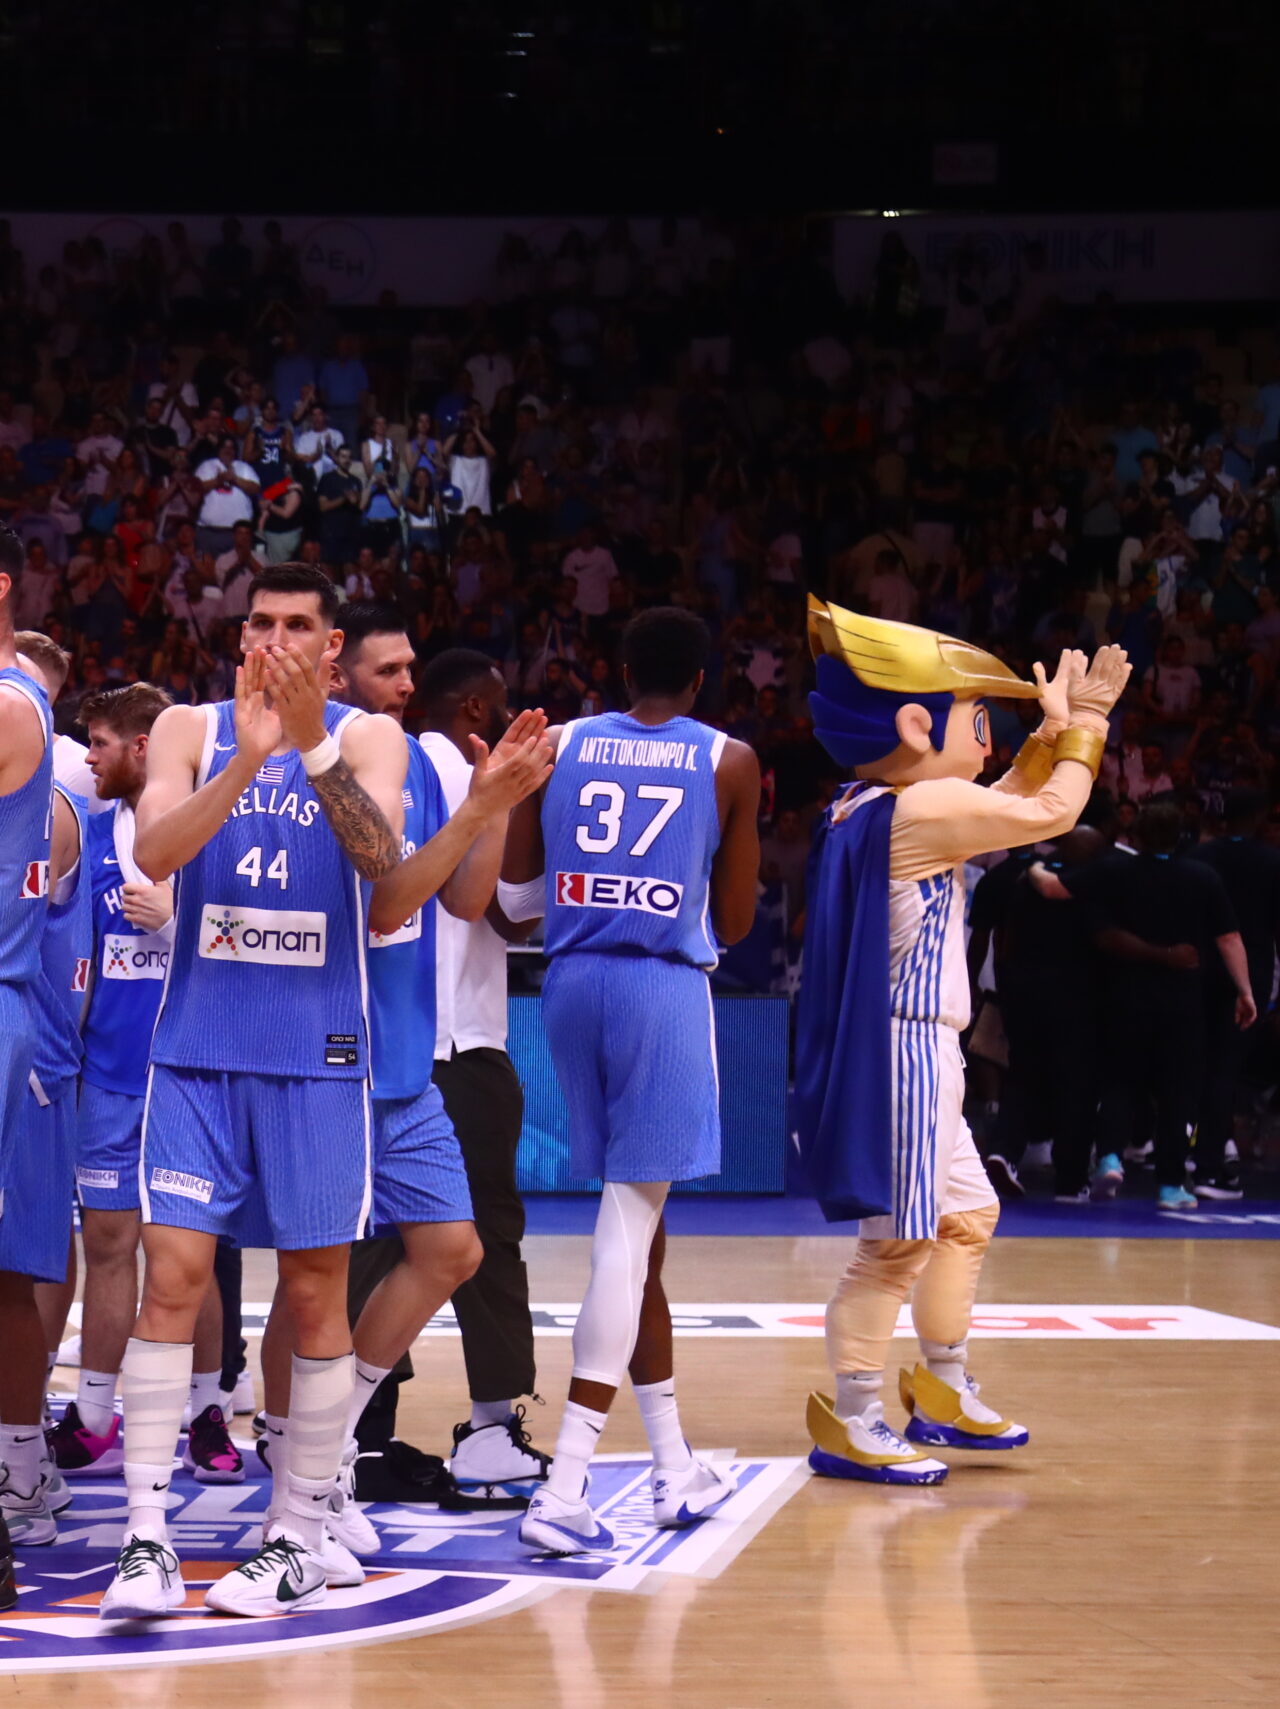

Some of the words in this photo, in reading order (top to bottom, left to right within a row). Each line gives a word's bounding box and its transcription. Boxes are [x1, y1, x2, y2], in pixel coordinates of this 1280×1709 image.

[261, 446, 280, 465] 34
[577, 737, 684, 769] ANTETOKOUNMPO
[684, 744, 698, 771] K.
[575, 778, 686, 858] 37
[235, 846, 290, 890] 44
[591, 877, 680, 912] EKO
